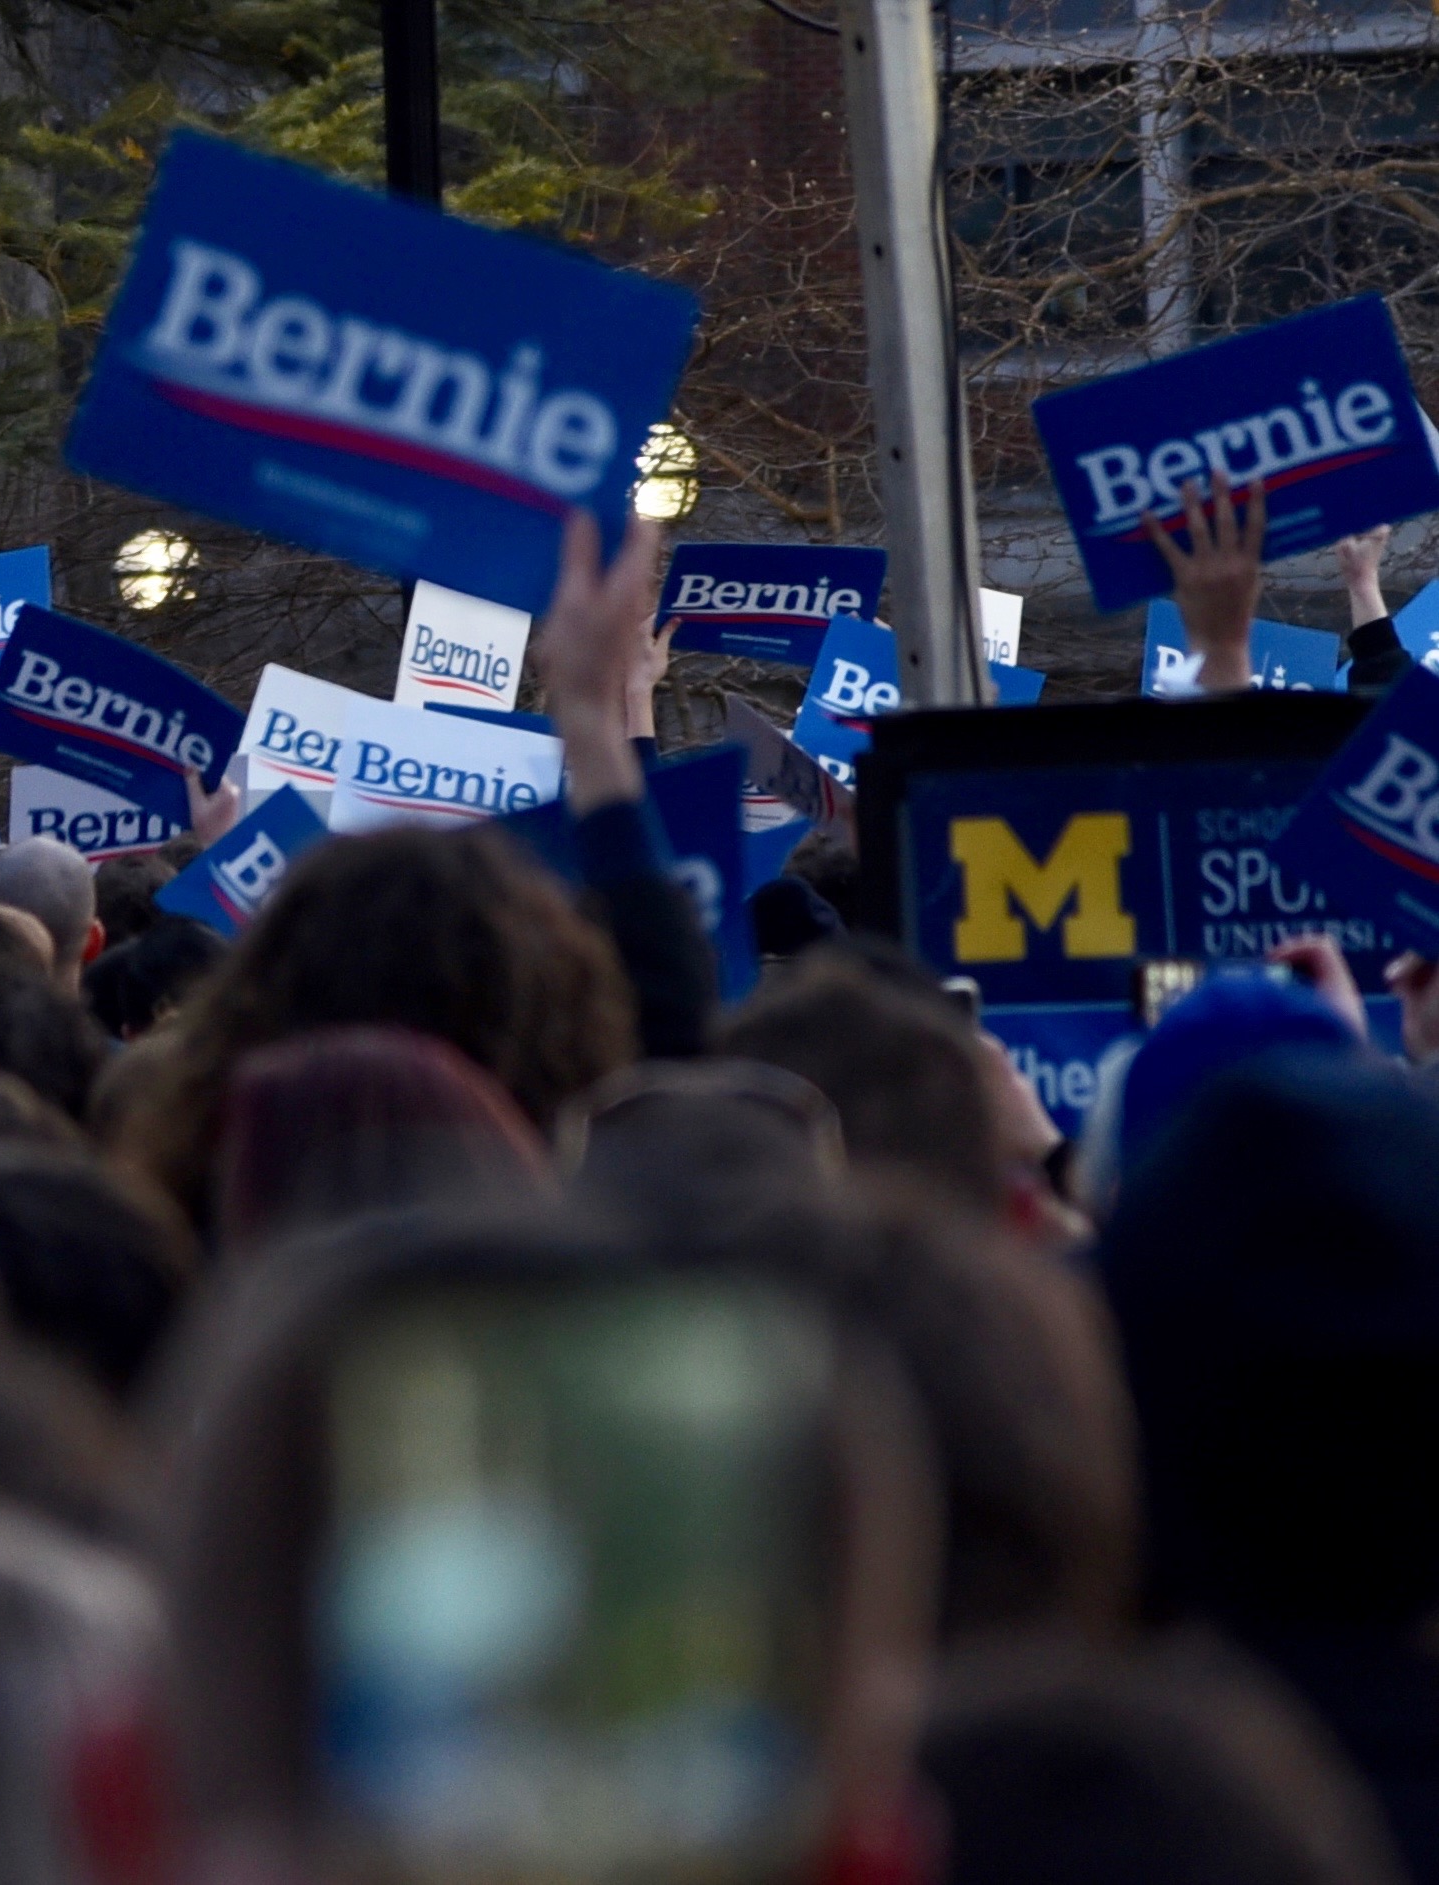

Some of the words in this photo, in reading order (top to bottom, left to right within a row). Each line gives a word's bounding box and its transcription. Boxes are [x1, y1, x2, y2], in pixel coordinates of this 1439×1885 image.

[147, 238, 618, 495] Bernie
[1075, 377, 1395, 523] Bernie
[671, 574, 862, 618] Bernie
[411, 624, 510, 692] Bernie
[7, 649, 212, 773] Bernie
[259, 708, 343, 772] Ber
[352, 739, 538, 813] Bernie
[949, 811, 1136, 963] M
